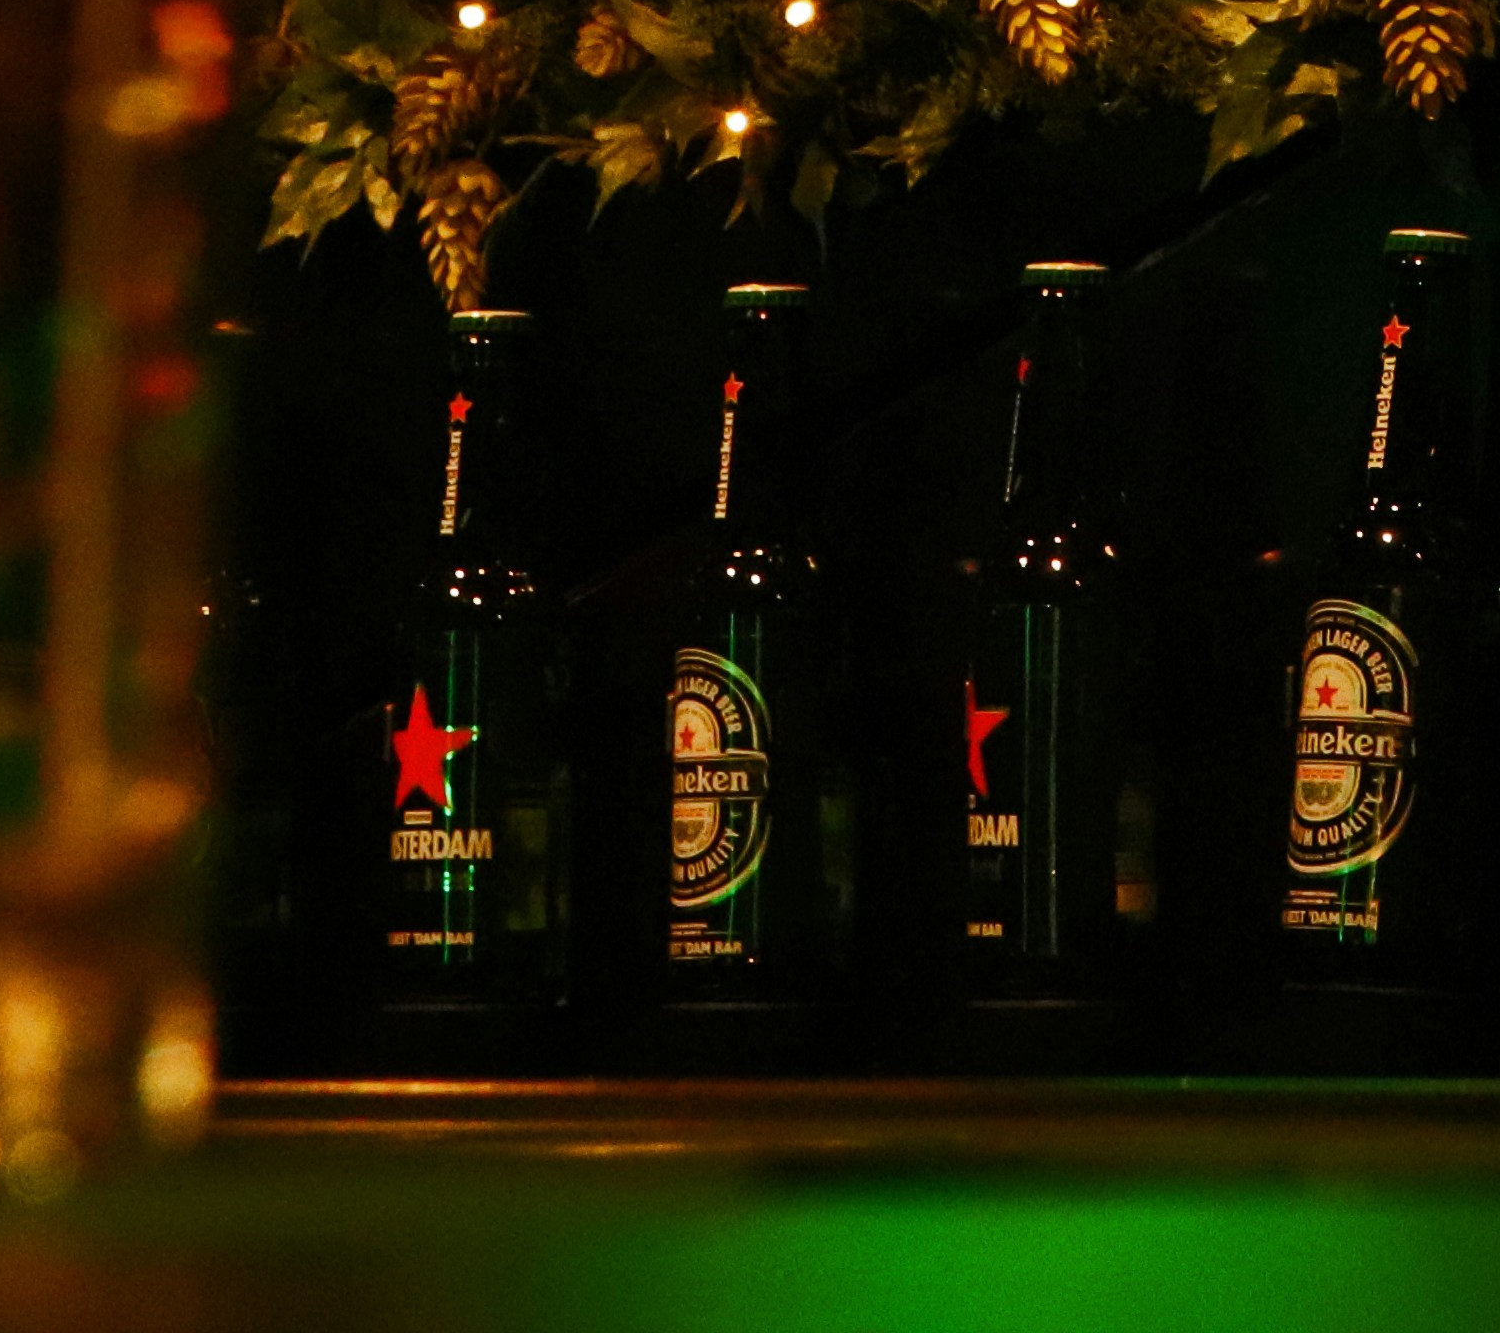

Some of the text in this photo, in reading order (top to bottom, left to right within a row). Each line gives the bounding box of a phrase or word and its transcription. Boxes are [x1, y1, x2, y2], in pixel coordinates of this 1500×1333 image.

[1368, 355, 1396, 469] Heineken
[440, 430, 462, 535] Heineken
[1326, 629, 1370, 659] LAGER
[1296, 725, 1397, 758] ineken
[1317, 792, 1384, 847] QUALITY
[390, 829, 493, 861] STERDAM
